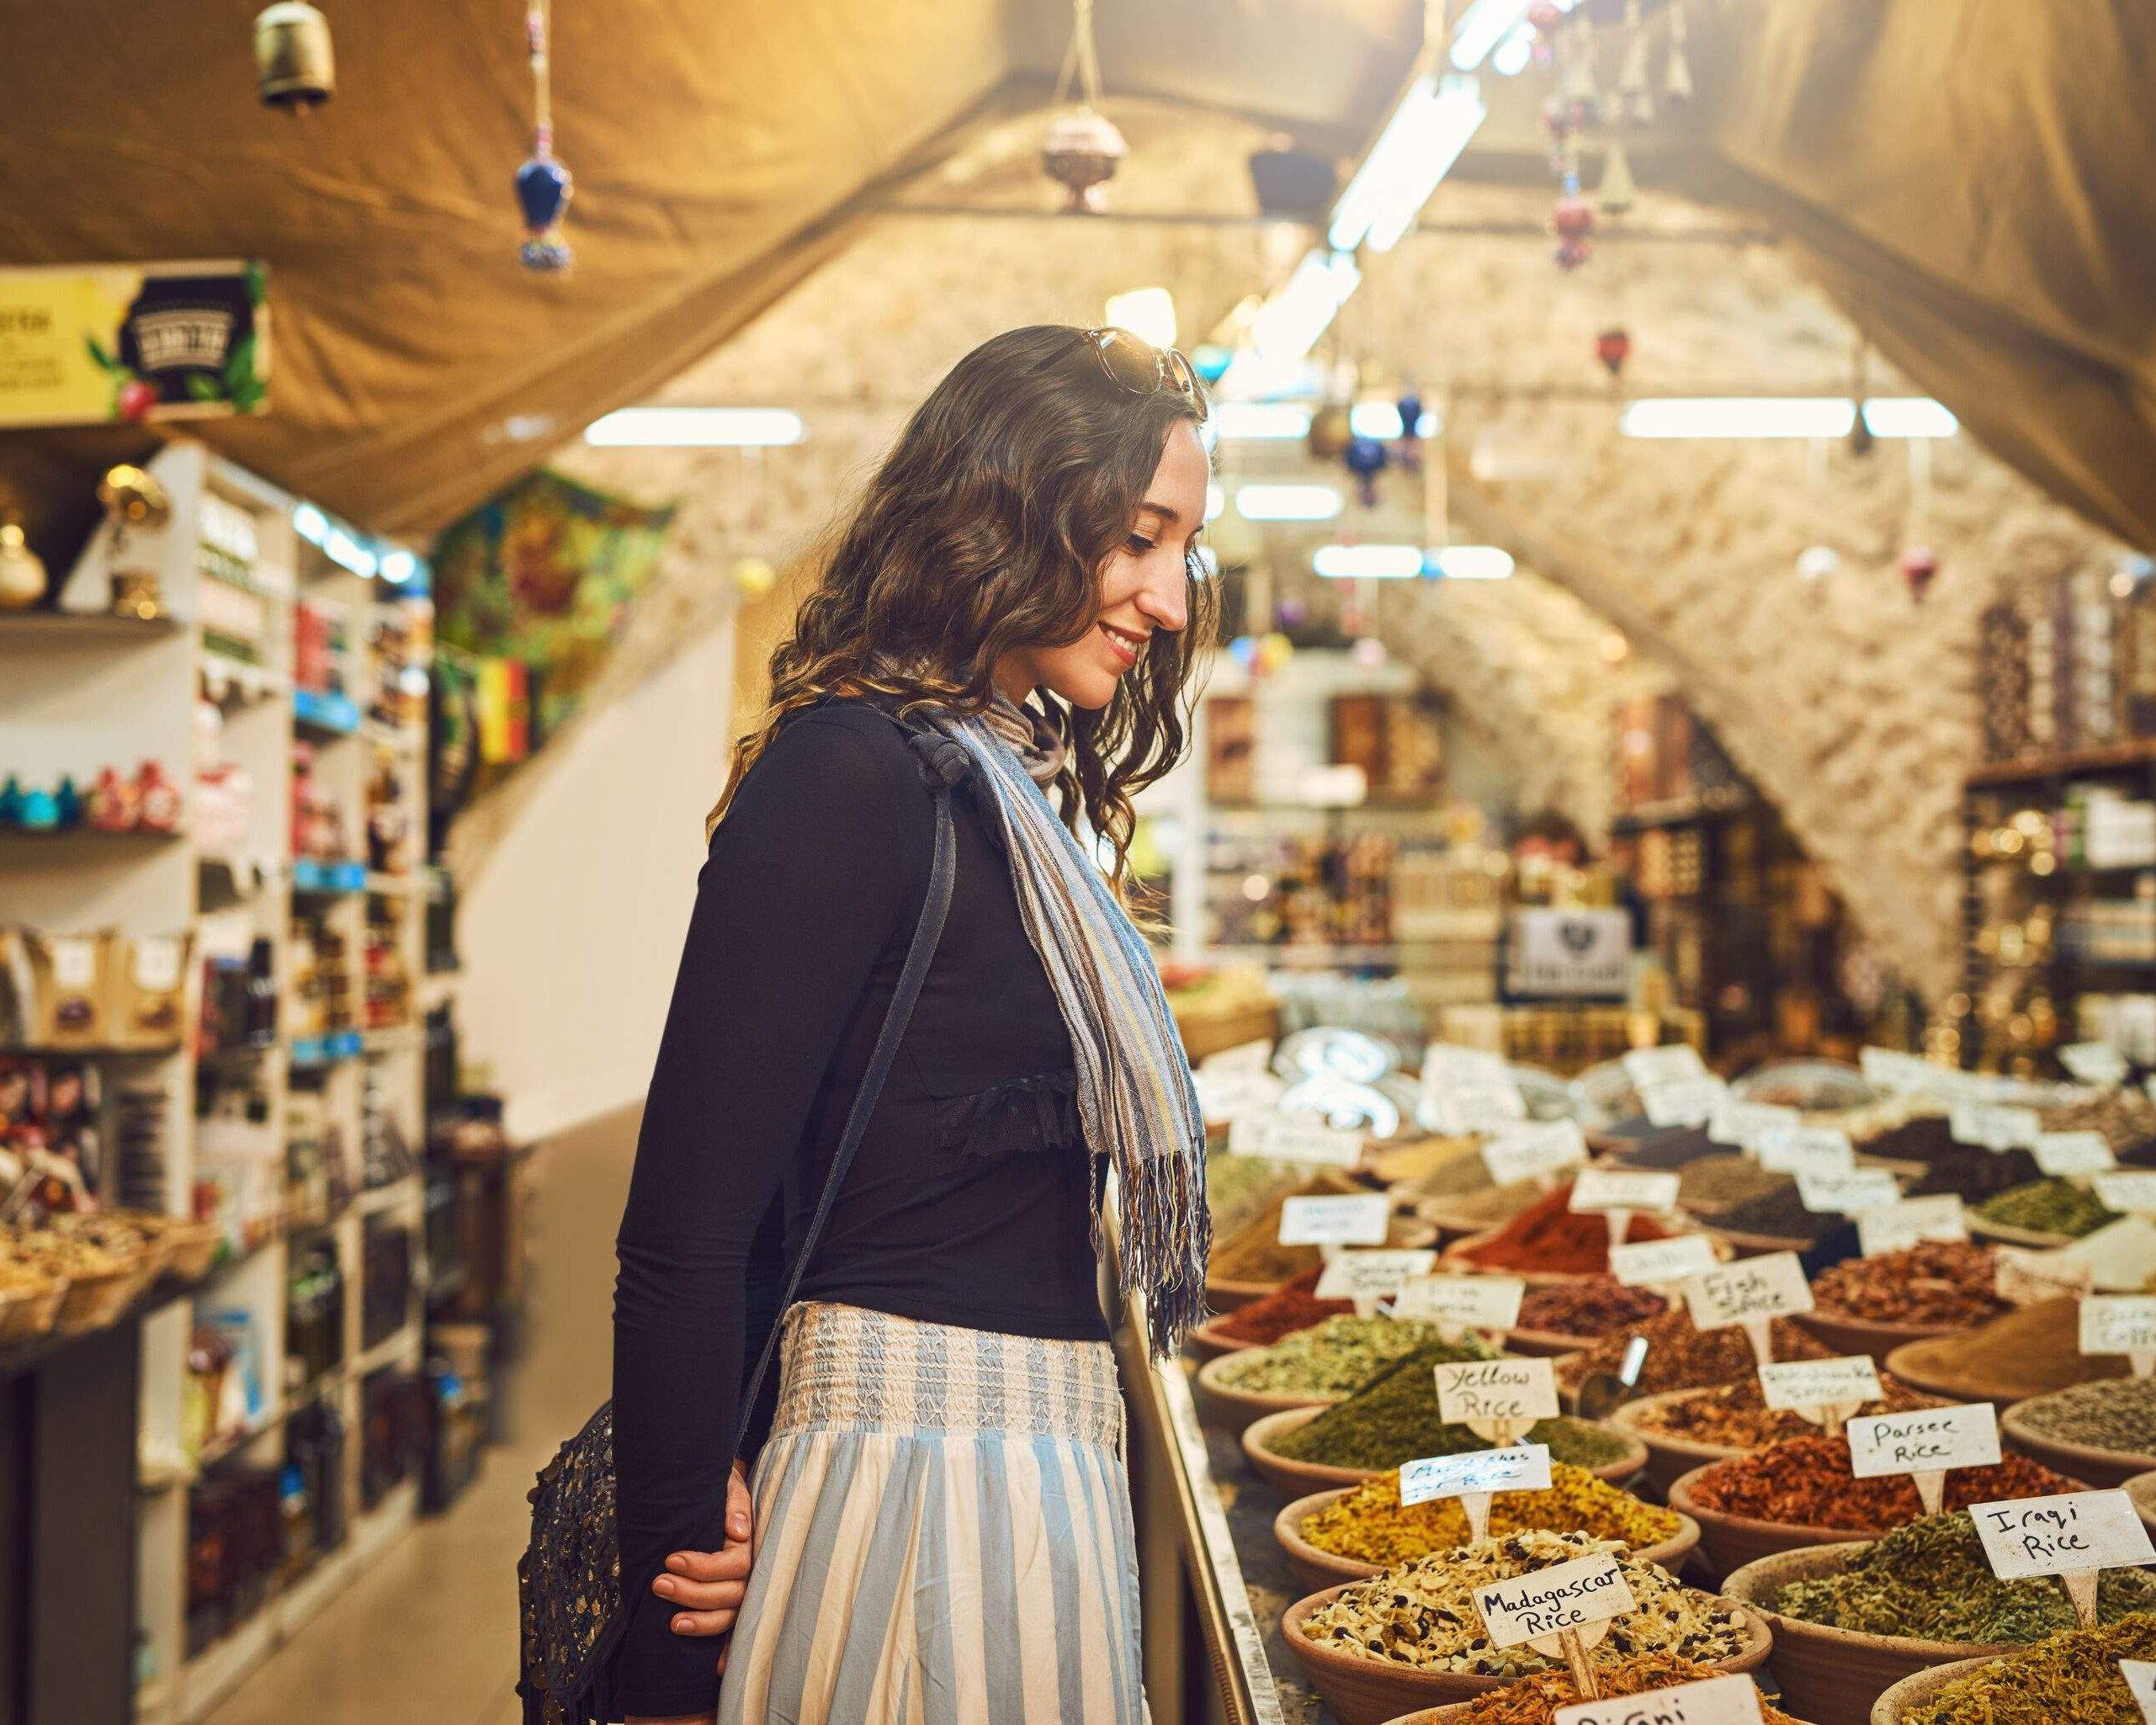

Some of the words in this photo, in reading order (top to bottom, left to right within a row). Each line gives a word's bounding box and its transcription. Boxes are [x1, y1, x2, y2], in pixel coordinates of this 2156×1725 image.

[1444, 1365, 1531, 1393] Yellow
[1457, 1390, 1524, 1418] Rice
[1874, 1420, 1958, 1447] Parsee
[1894, 1444, 1952, 1462] Rice
[1987, 1501, 2078, 1533] Iraqi
[2021, 1534, 2090, 1559] Rice
[1484, 1568, 1618, 1616] Madagascar
[1515, 1609, 1586, 1635] Rice
